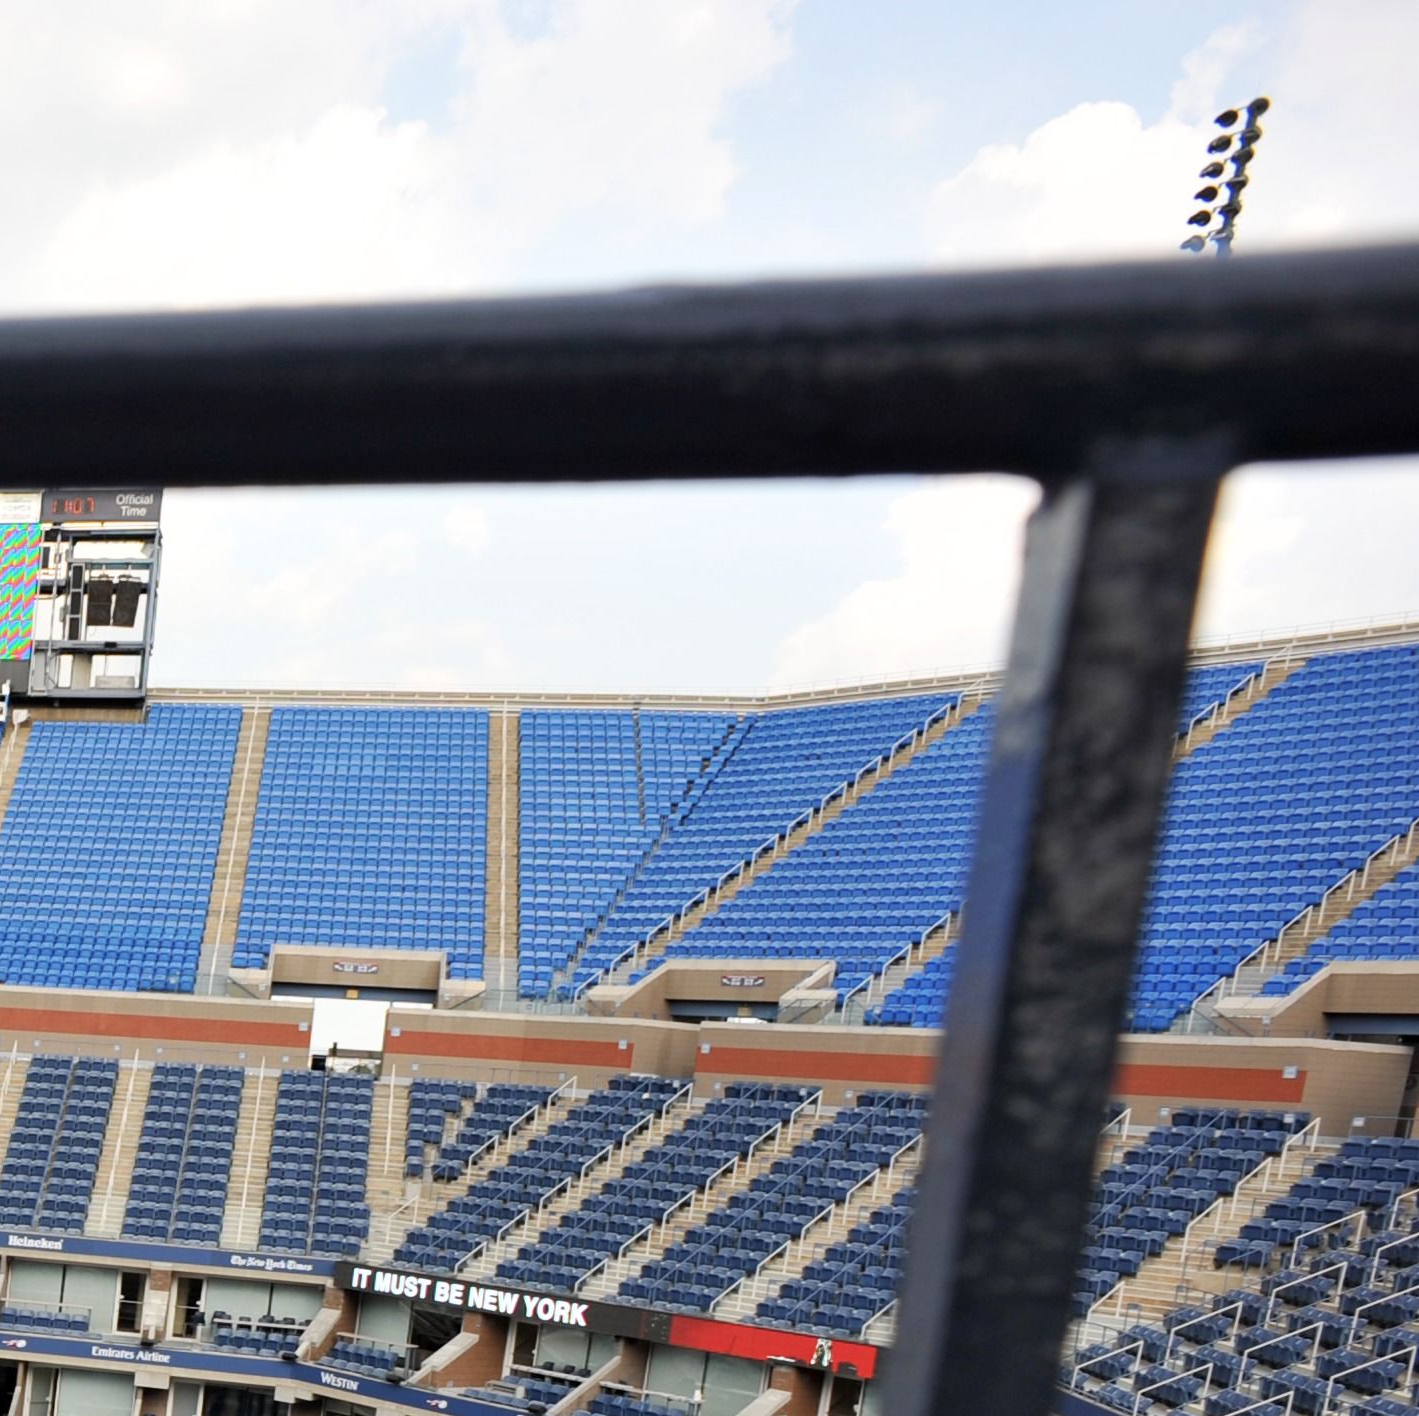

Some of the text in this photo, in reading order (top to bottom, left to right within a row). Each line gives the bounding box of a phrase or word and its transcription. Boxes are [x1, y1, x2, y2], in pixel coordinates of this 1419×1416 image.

[116, 494, 154, 506] Official
[120, 505, 147, 517] Time
[7, 1234, 63, 1250] Heineken
[230, 1254, 313, 1272] The New York Times
[351, 1267, 589, 1327] IT MUST BE NEW YORK
[91, 1345, 171, 1364] Emirates Airline
